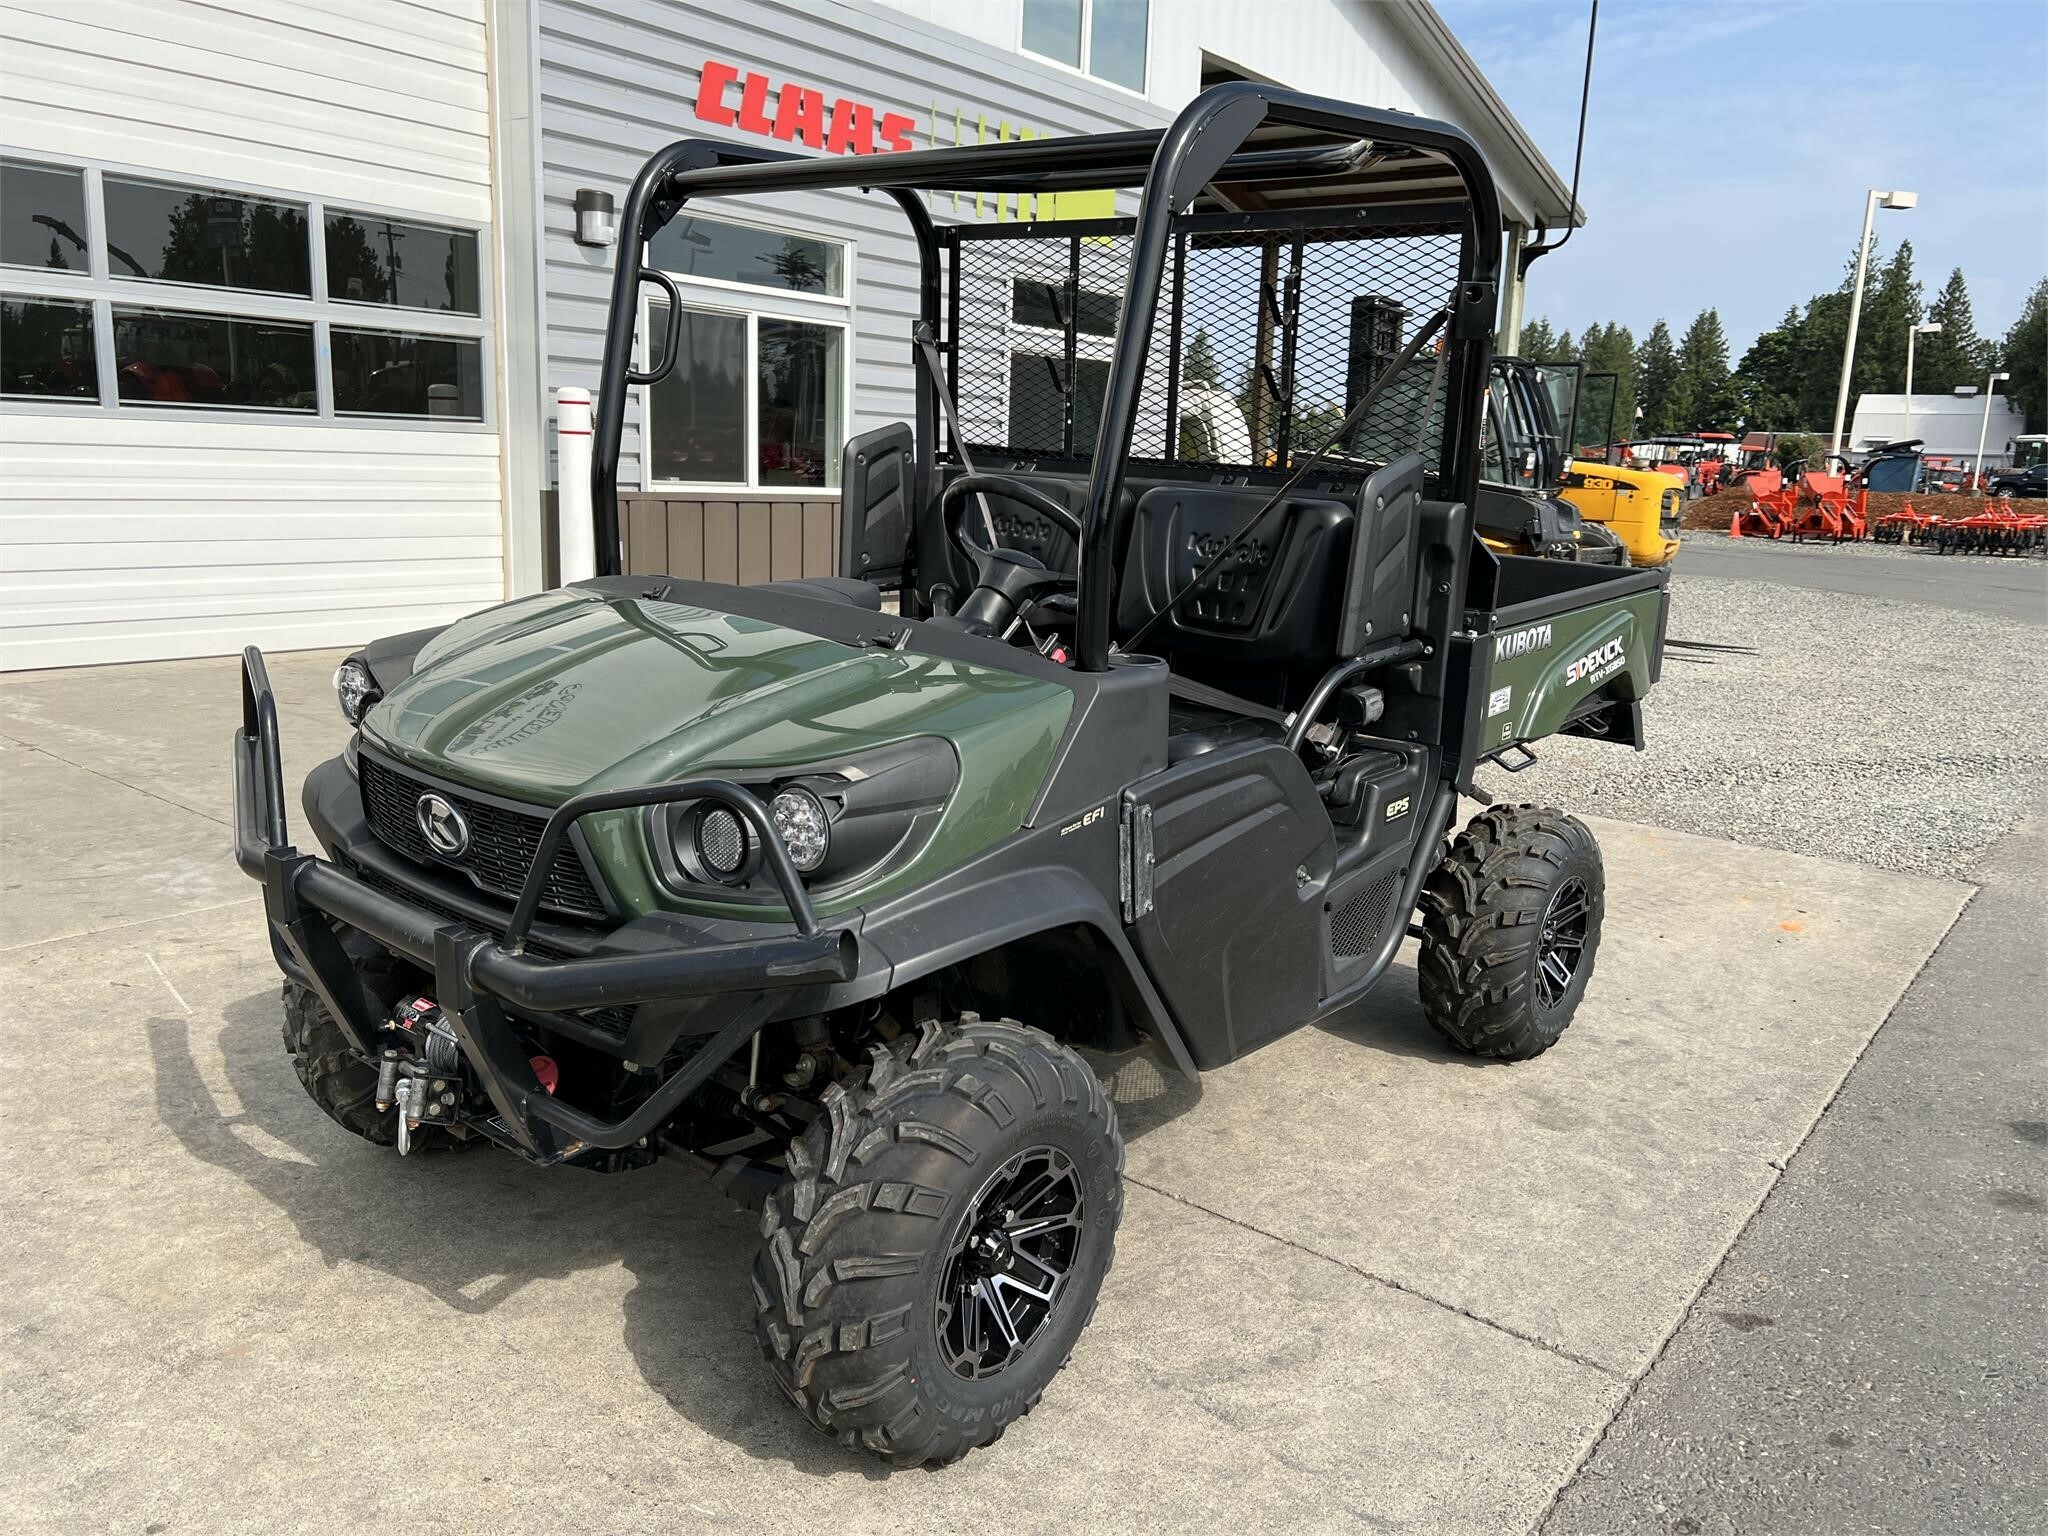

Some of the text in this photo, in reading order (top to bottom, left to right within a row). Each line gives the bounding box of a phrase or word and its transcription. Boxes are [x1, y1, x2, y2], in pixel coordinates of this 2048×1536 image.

[695, 61, 915, 154] CLAAS
[1495, 624, 1552, 664] KUBOTA
[1565, 635, 1624, 687] SIDEKICK
[1083, 806, 1105, 826] EFI
[1386, 796, 1410, 817] EPS
